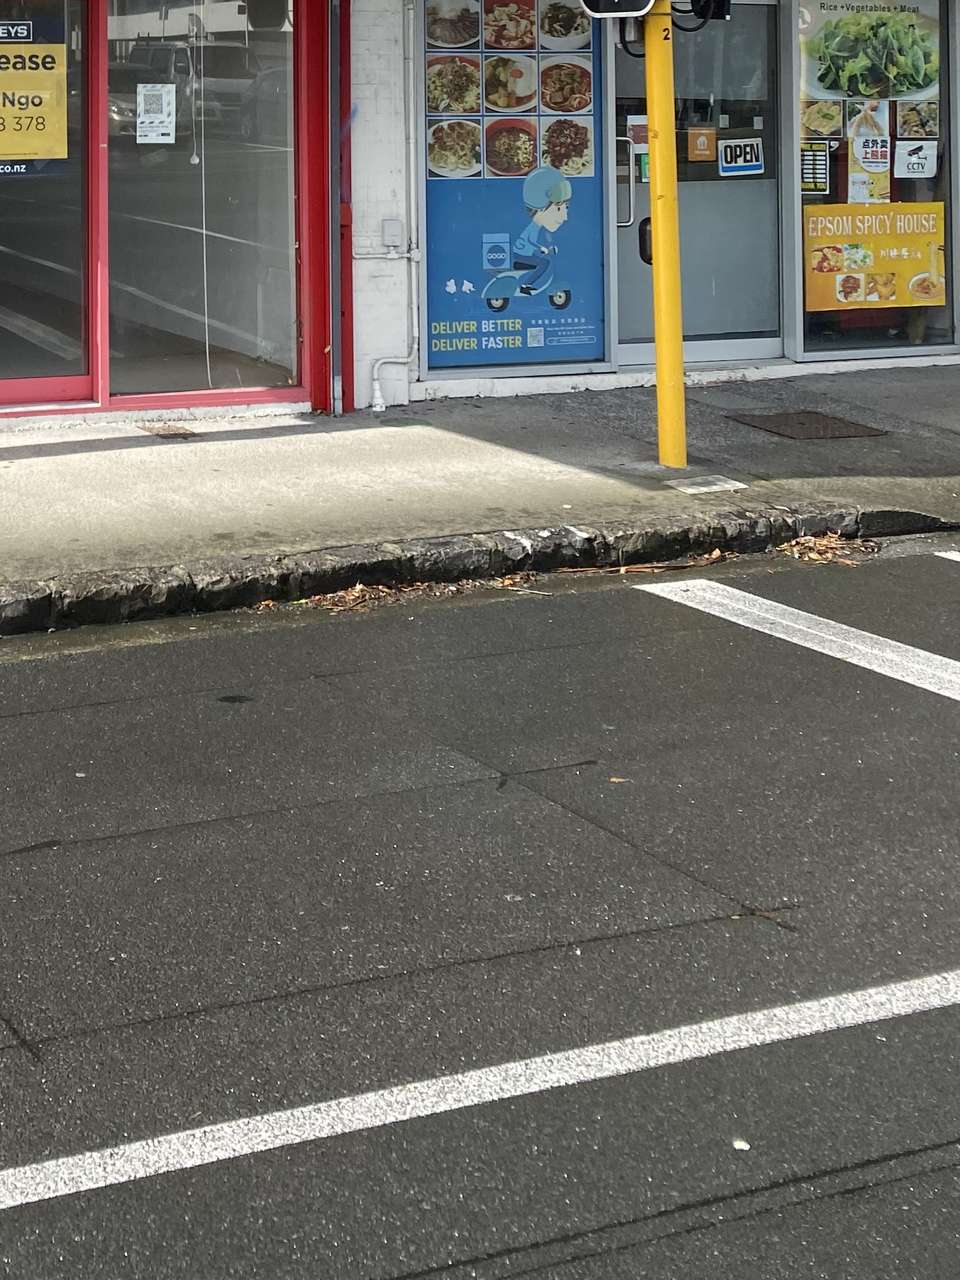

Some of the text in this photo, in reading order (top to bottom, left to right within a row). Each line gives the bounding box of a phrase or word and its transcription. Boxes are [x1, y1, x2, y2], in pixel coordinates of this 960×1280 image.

[819, 3, 838, 12] Rice
[662, 28, 671, 41] 2
[2, 92, 44, 111] Ngo
[13, 116, 46, 132] 378
[724, 143, 760, 165] OPEN
[906, 162, 926, 171] CCTV
[808, 212, 937, 236] EPSOM SPICY HOUSE
[432, 321, 477, 335] DELIVER
[482, 319, 522, 333] BETTER
[432, 336, 522, 352] DELIVER FASTER
